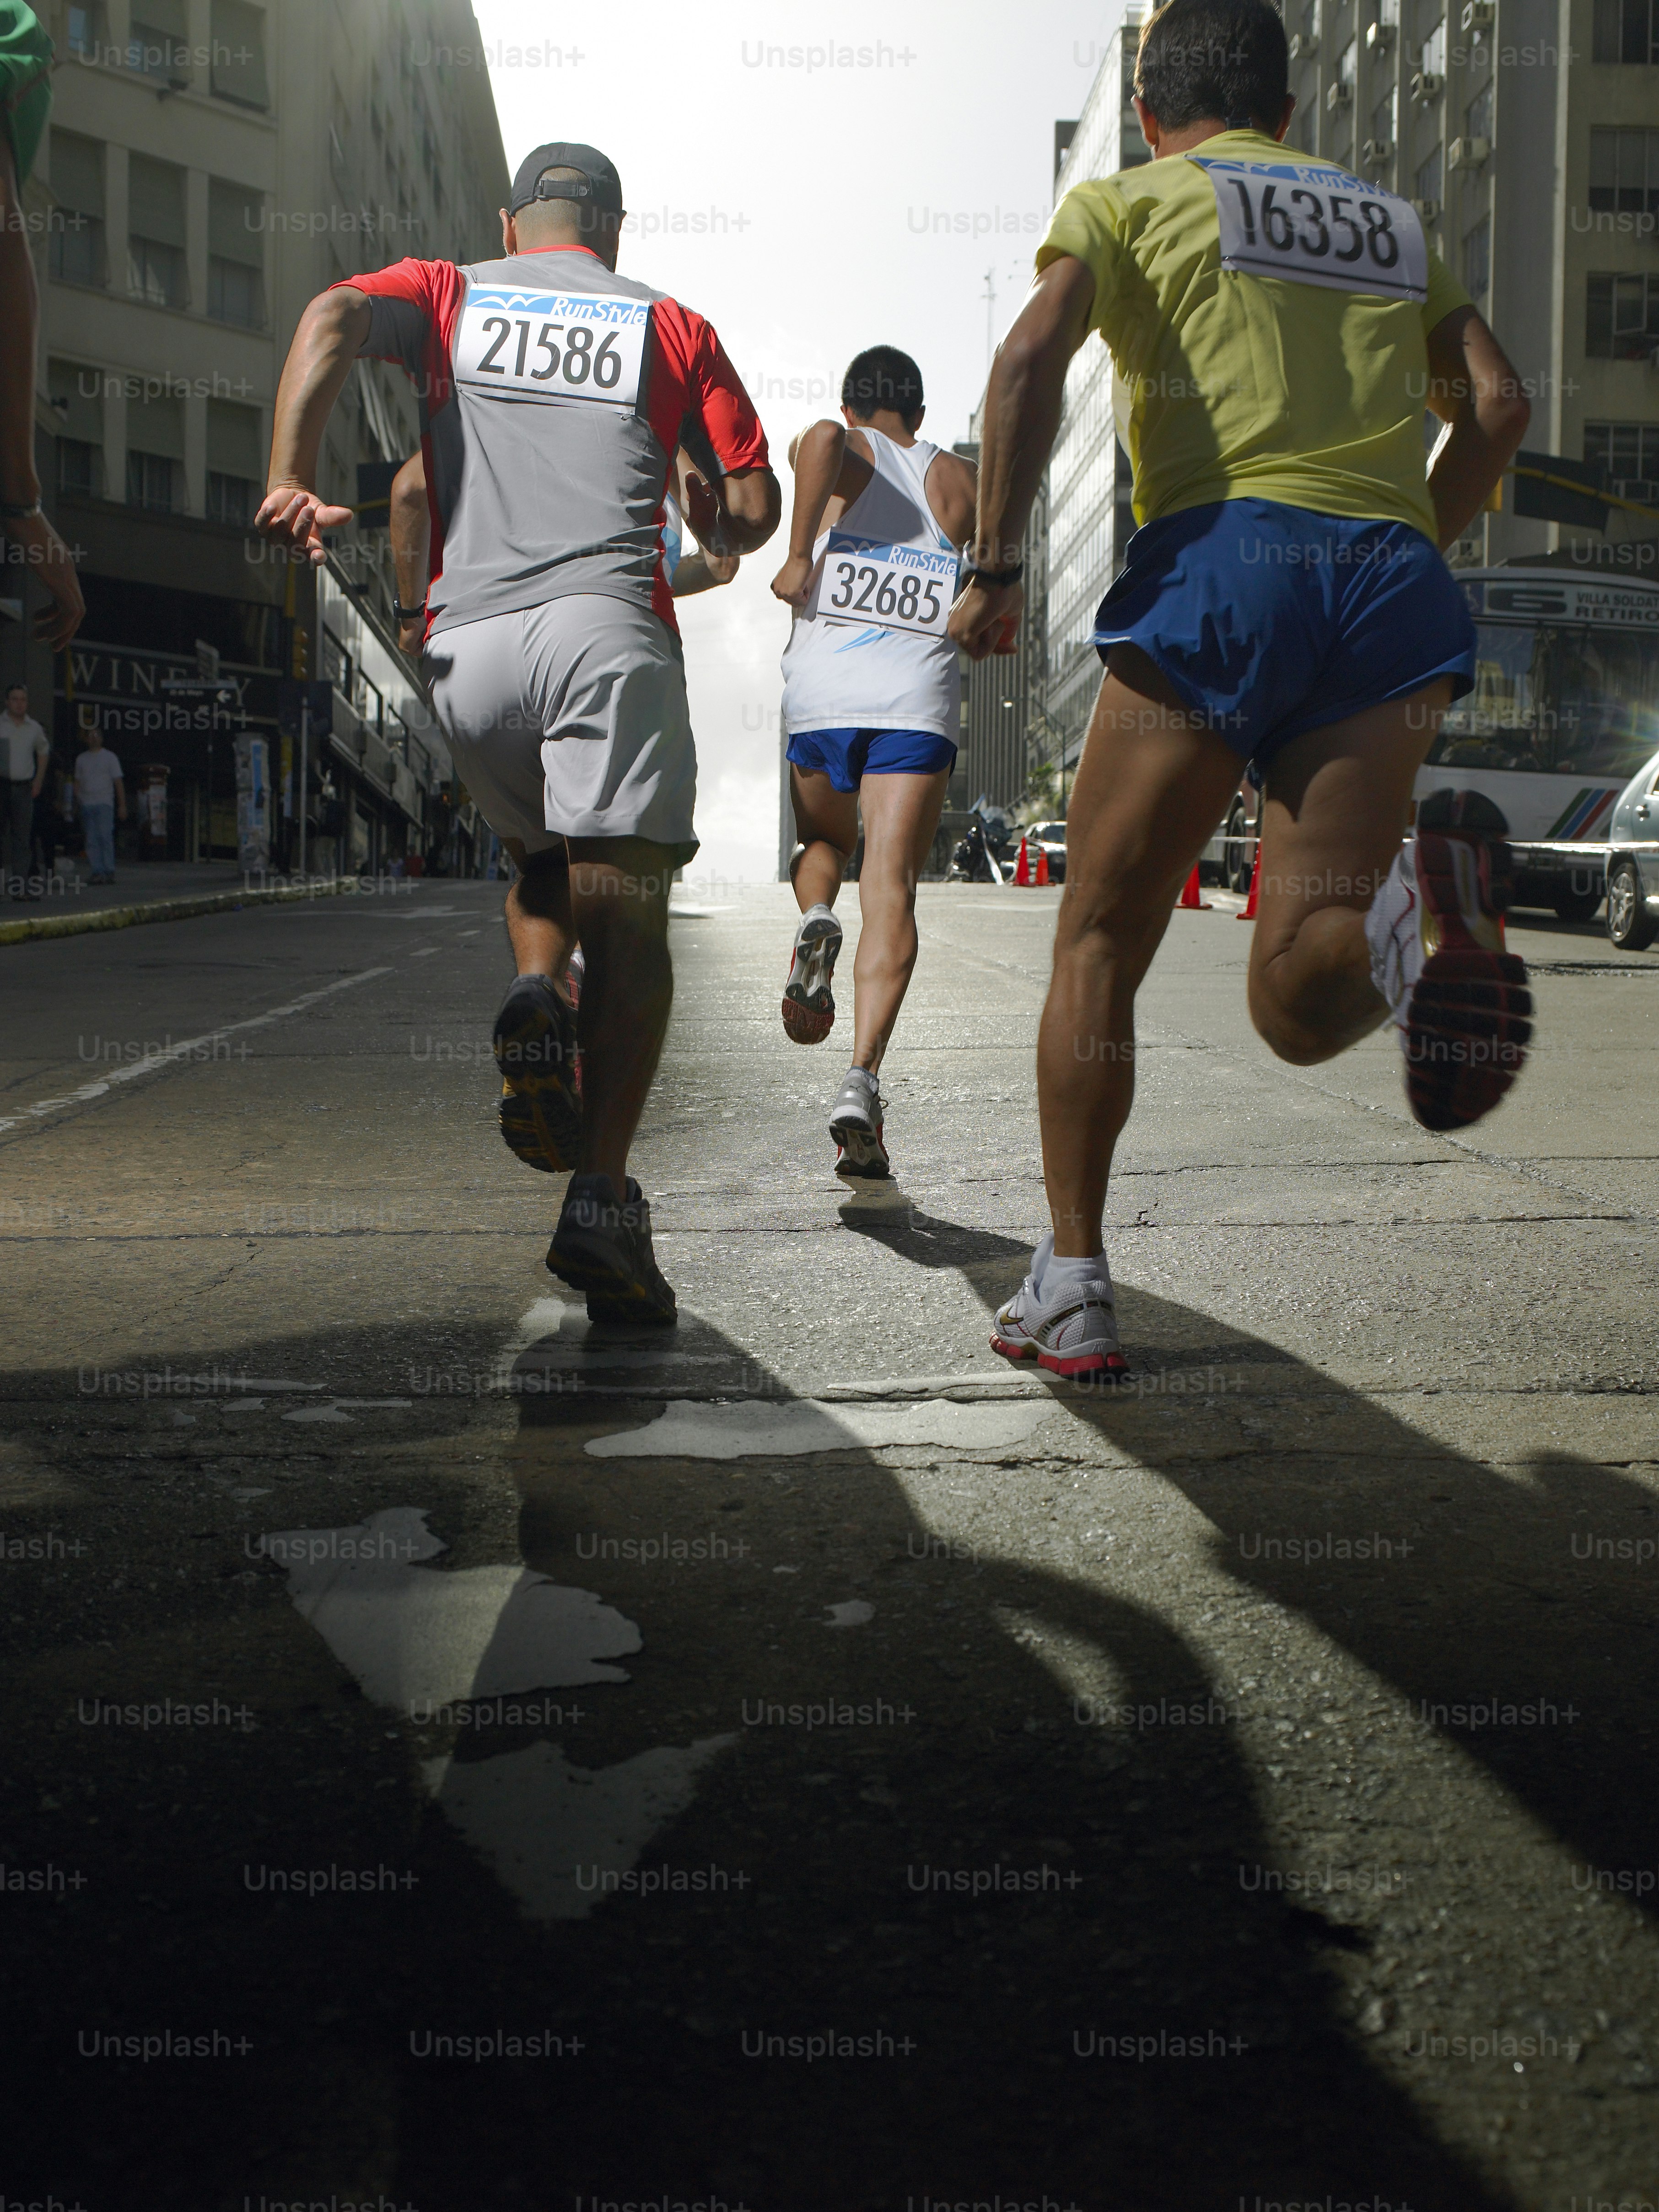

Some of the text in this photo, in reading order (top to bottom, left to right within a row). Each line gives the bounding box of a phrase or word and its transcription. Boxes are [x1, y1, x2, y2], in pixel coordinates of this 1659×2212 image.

[1228, 178, 1399, 269] 16358
[550, 297, 647, 324] RunStyle
[477, 317, 621, 388] 21586
[888, 545, 957, 576] RunStyle
[831, 562, 943, 624] 32685
[1488, 588, 1567, 614] 6
[1577, 592, 1610, 604] VILLA
[1575, 606, 1659, 621] RETIRO
[70, 653, 251, 706] WINY
